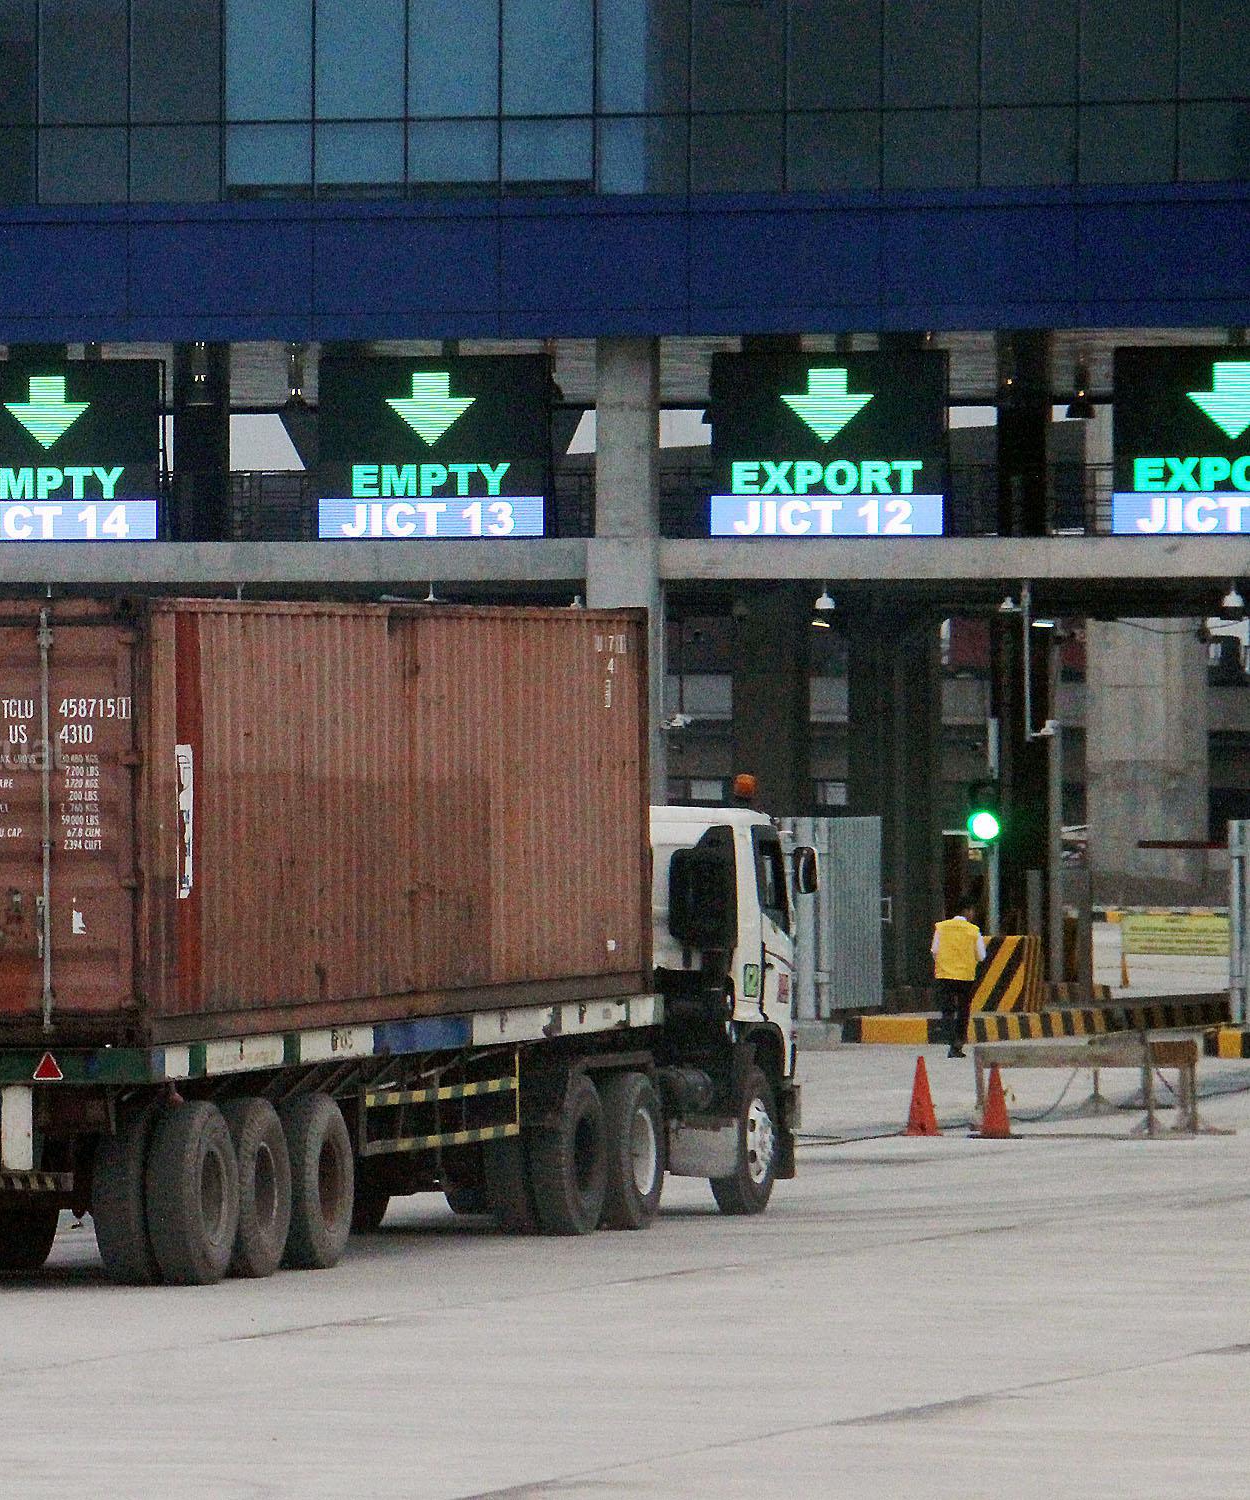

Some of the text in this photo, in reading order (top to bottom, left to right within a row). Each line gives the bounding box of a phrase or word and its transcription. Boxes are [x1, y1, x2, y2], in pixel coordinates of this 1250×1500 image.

[351, 463, 511, 497] EMPTY
[730, 460, 923, 495] EXPORT
[78, 505, 130, 539] 14
[342, 501, 515, 537] JICT 13
[733, 500, 914, 534] JICT 12
[1135, 496, 1250, 533] JICT
[2, 699, 35, 719] TCLU
[8, 724, 94, 744] US 4310
